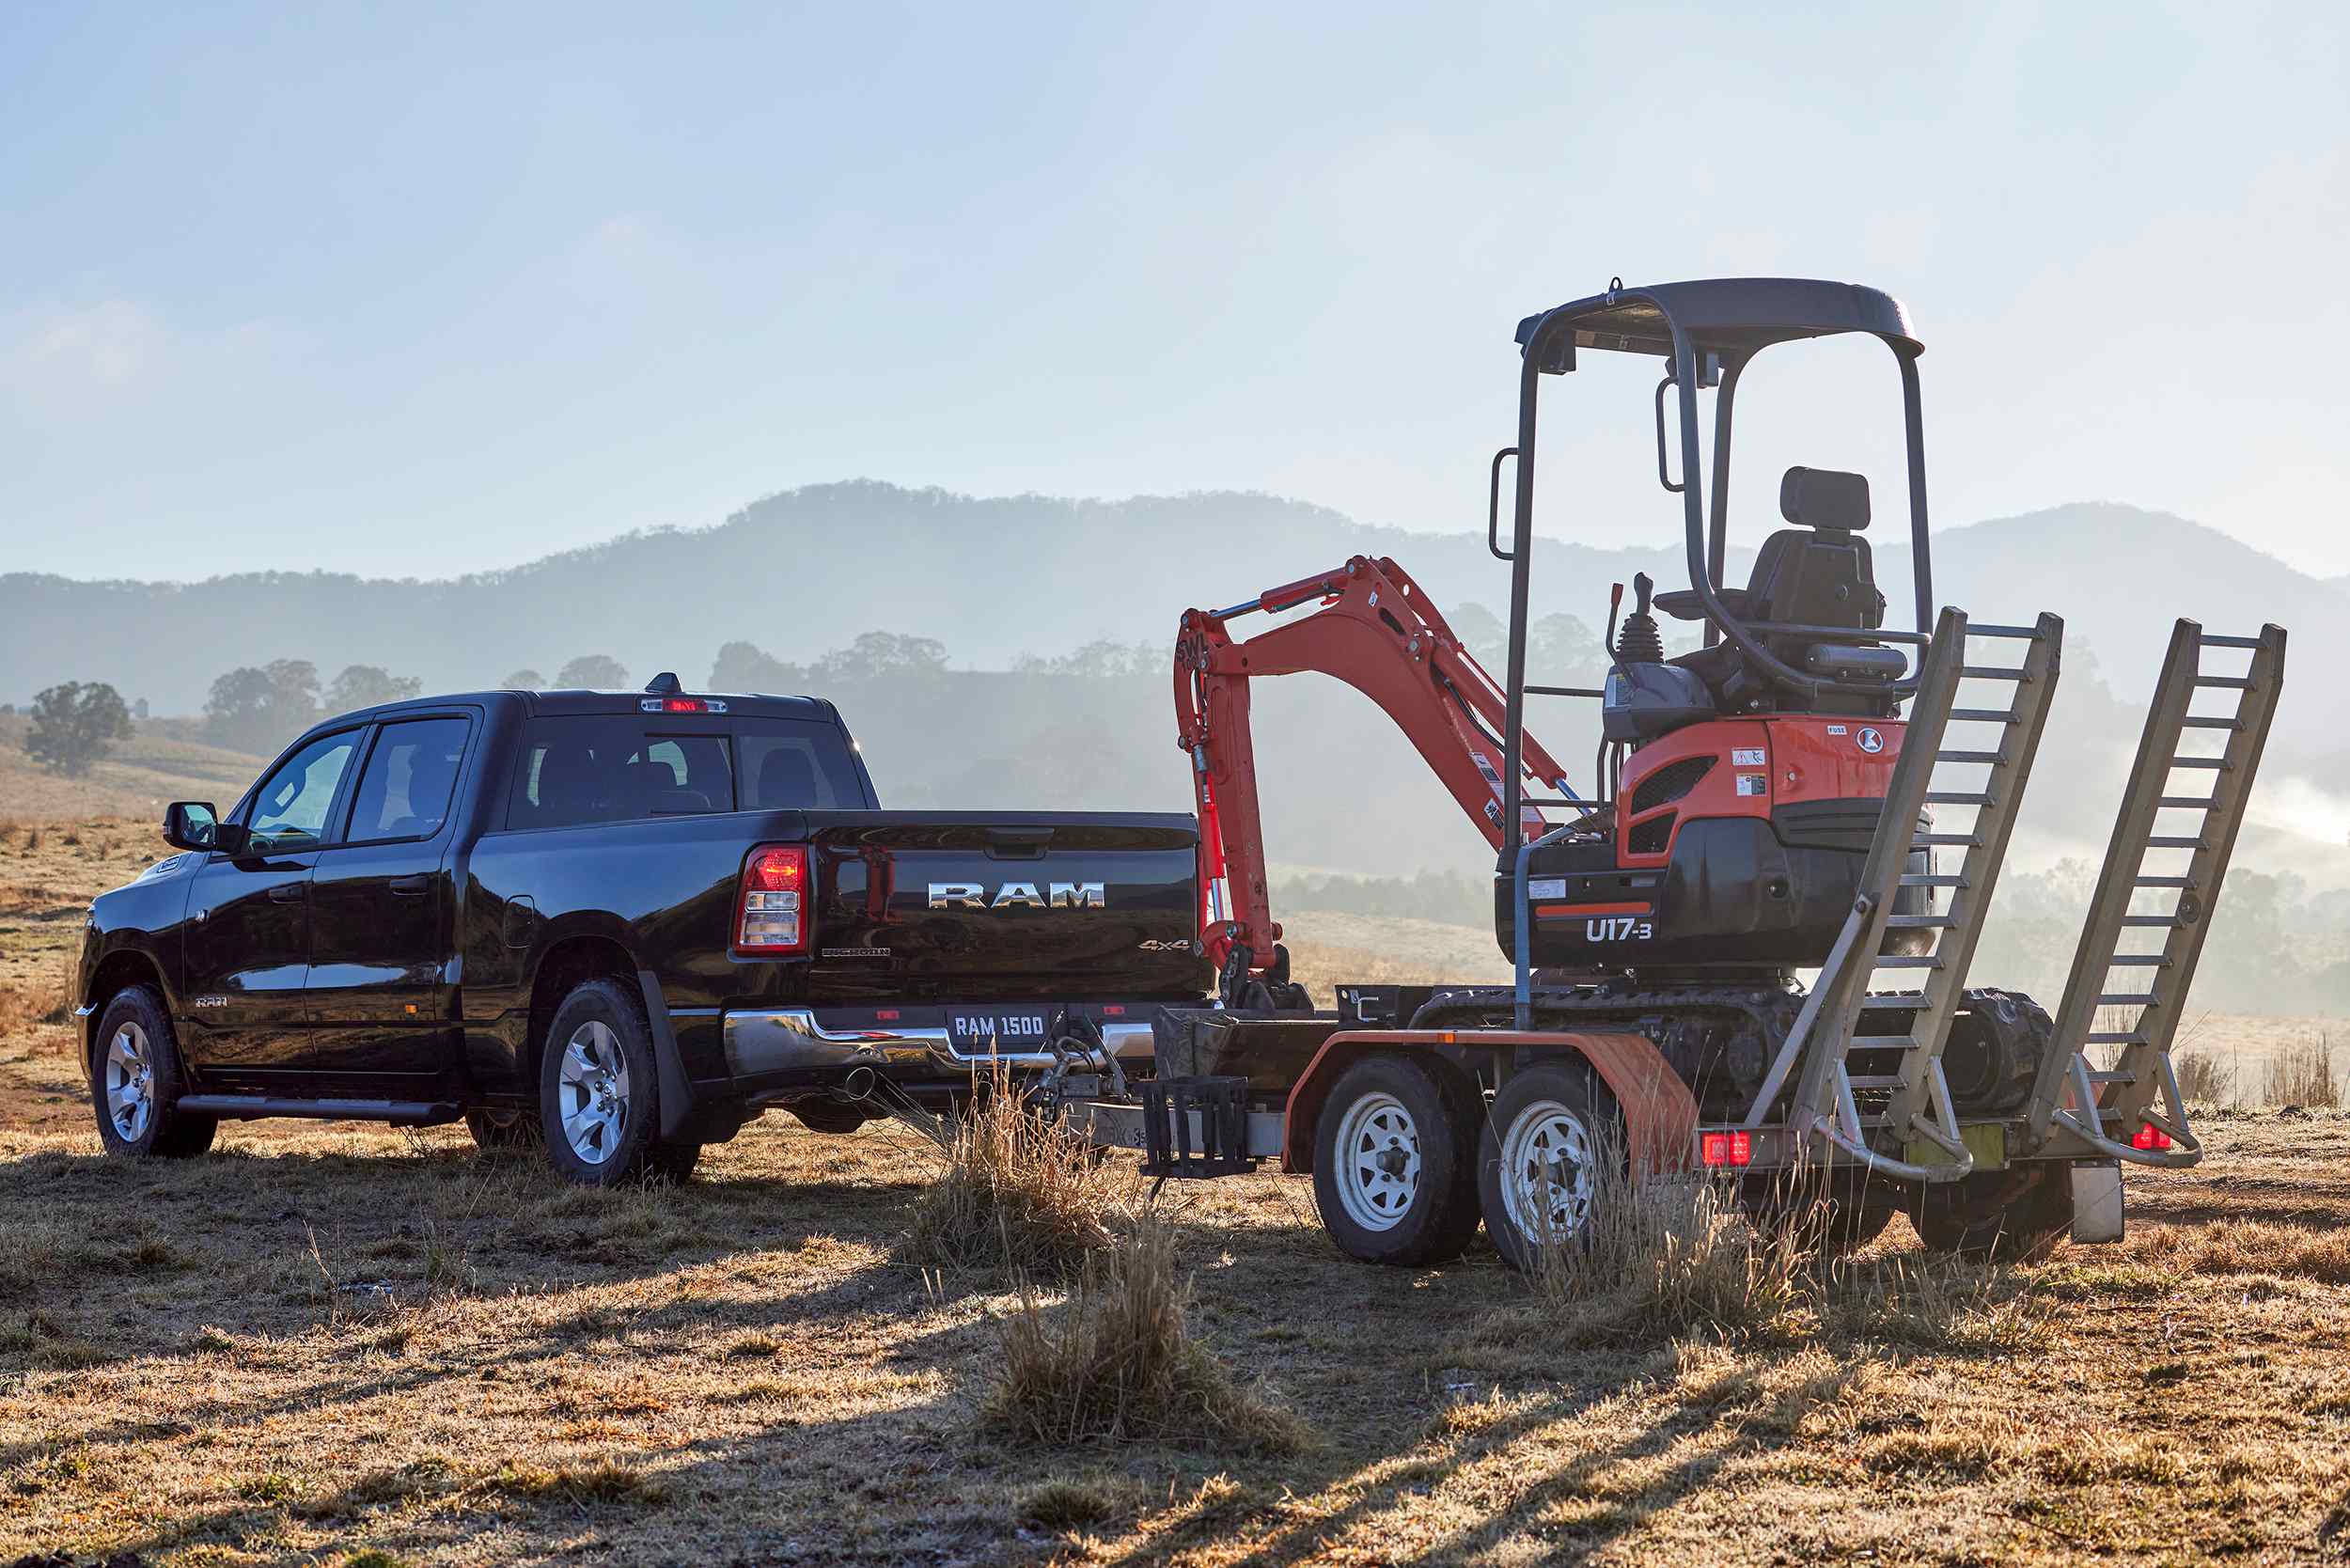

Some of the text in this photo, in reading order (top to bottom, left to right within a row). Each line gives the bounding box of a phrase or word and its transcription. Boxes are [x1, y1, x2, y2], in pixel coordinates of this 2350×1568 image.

[929, 882, 1105, 908] RAM
[1586, 917, 1652, 942] U17-3
[955, 1016, 1043, 1035] RAM 1500
